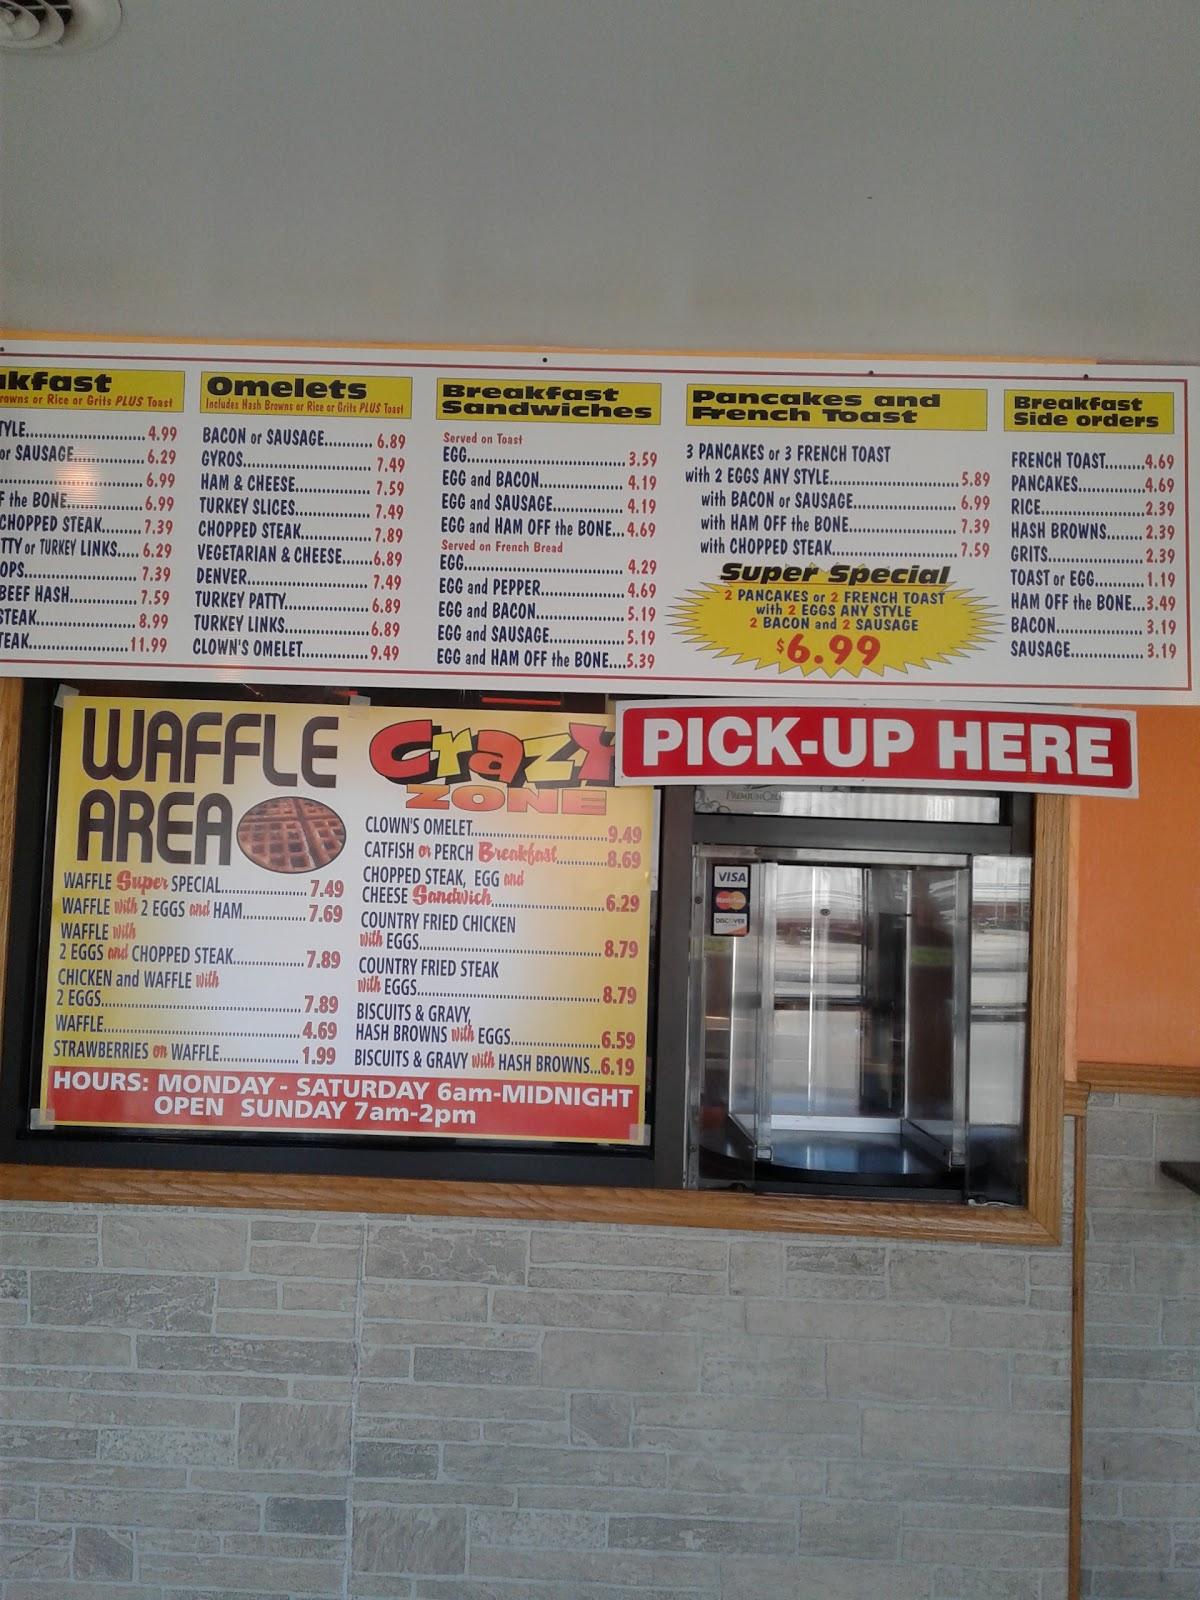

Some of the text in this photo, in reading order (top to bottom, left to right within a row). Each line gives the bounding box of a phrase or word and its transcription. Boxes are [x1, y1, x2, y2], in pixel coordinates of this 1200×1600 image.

[207, 377, 366, 399] Omelets
[443, 384, 619, 401] Breakfast
[206, 398, 238, 409] Includes
[242, 398, 261, 410] Hash
[265, 400, 293, 411] Browns
[307, 401, 324, 411] Rice
[338, 402, 356, 412] Grits
[360, 402, 381, 413] PLUS
[384, 403, 403, 414] Toast
[693, 390, 940, 407] Pancakes and
[1015, 396, 1142, 411] Breakfast
[442, 401, 651, 418] Sandwiches
[693, 407, 917, 423] French Toast
[1014, 412, 1158, 427] Side orders
[149, 426, 177, 441] 4.99
[203, 427, 405, 449] BACON or 6.89
[443, 432, 522, 444] Served on Toast
[148, 449, 176, 464] 6.29
[629, 452, 657, 467] 3.59
[687, 443, 891, 463] 3 PANCAKES or 3 FRENCH TOAST
[1012, 451, 1061, 468] FRENCH
[378, 457, 405, 473] 7.49
[147, 472, 175, 488] 6.99
[201, 473, 404, 496] HAM 7.59
[443, 470, 656, 490] EGG and 4.19
[686, 466, 990, 487] with 2 EGGS ANY 5.89
[145, 496, 174, 511] 6.99
[200, 497, 403, 520] TURKEY 7.49
[702, 490, 990, 510] with BACON or 6.99
[145, 519, 173, 535] 7.39
[199, 520, 403, 543] CHOPPED 7.89
[441, 517, 573, 535] EGG and HAM OFF the
[962, 519, 990, 534] 7.39
[1012, 521, 1174, 540] HASH 2.39
[143, 543, 171, 558] 6.29
[198, 544, 276, 562] VEGETARIAN
[441, 539, 475, 550] Served
[496, 541, 529, 552] French
[534, 542, 562, 553] Bread
[730, 537, 989, 558] CHOPPED 7.59
[1146, 548, 1175, 564] 2.39
[143, 566, 170, 582] 7.39
[628, 559, 656, 575] 4.29
[720, 563, 950, 586] Super Special
[374, 575, 401, 590] 7.49
[1011, 569, 1175, 587] TOAST or 1.19
[142, 590, 169, 605] 7.59
[628, 583, 656, 598] 4.69
[725, 589, 945, 604] 2 PANCAKES or 2 FRENCH TOAST
[195, 591, 400, 614] TURKEY 6.89
[757, 603, 911, 617] with 2 EGGS ANY STYLE
[139, 613, 168, 629] 8.99
[628, 606, 655, 622] 5.19
[750, 617, 918, 631] 2 BACON and 2 SAUSAGE
[1147, 619, 1176, 635] 3.19
[131, 637, 167, 652] 11.99
[193, 638, 399, 661] CLOWN'S 9.49
[1148, 643, 1176, 659] 3.19
[83, 708, 339, 788] WAFFLE
[643, 716, 1113, 777] PICK-UP HERE
[406, 784, 606, 816] ZONE
[77, 789, 232, 865] AREA
[365, 841, 473, 861] CATFISH or PERCH
[64, 870, 344, 898] WAFFLE Super 7.49
[719, 872, 746, 882] VISA
[309, 905, 342, 923] 7.69
[361, 911, 515, 933] COUNTRY FRIED CHICKEN
[132, 945, 340, 969] CHOPPED 7.89
[605, 940, 638, 958] 8.79
[359, 957, 499, 978] COUNTRY FRIED STEAK
[59, 968, 219, 988] CHICKEN and WAFFLE with
[603, 986, 636, 1004] 8.79
[303, 1022, 337, 1040] 4.69
[54, 1040, 336, 1065] STRAWBERRIES on 1.99
[54, 1071, 633, 1107] HOURS: MONDAY SATURDAY 6am-MIDNIGHT
[155, 1096, 475, 1128] OPEN SUNDAY 7am-2pm
